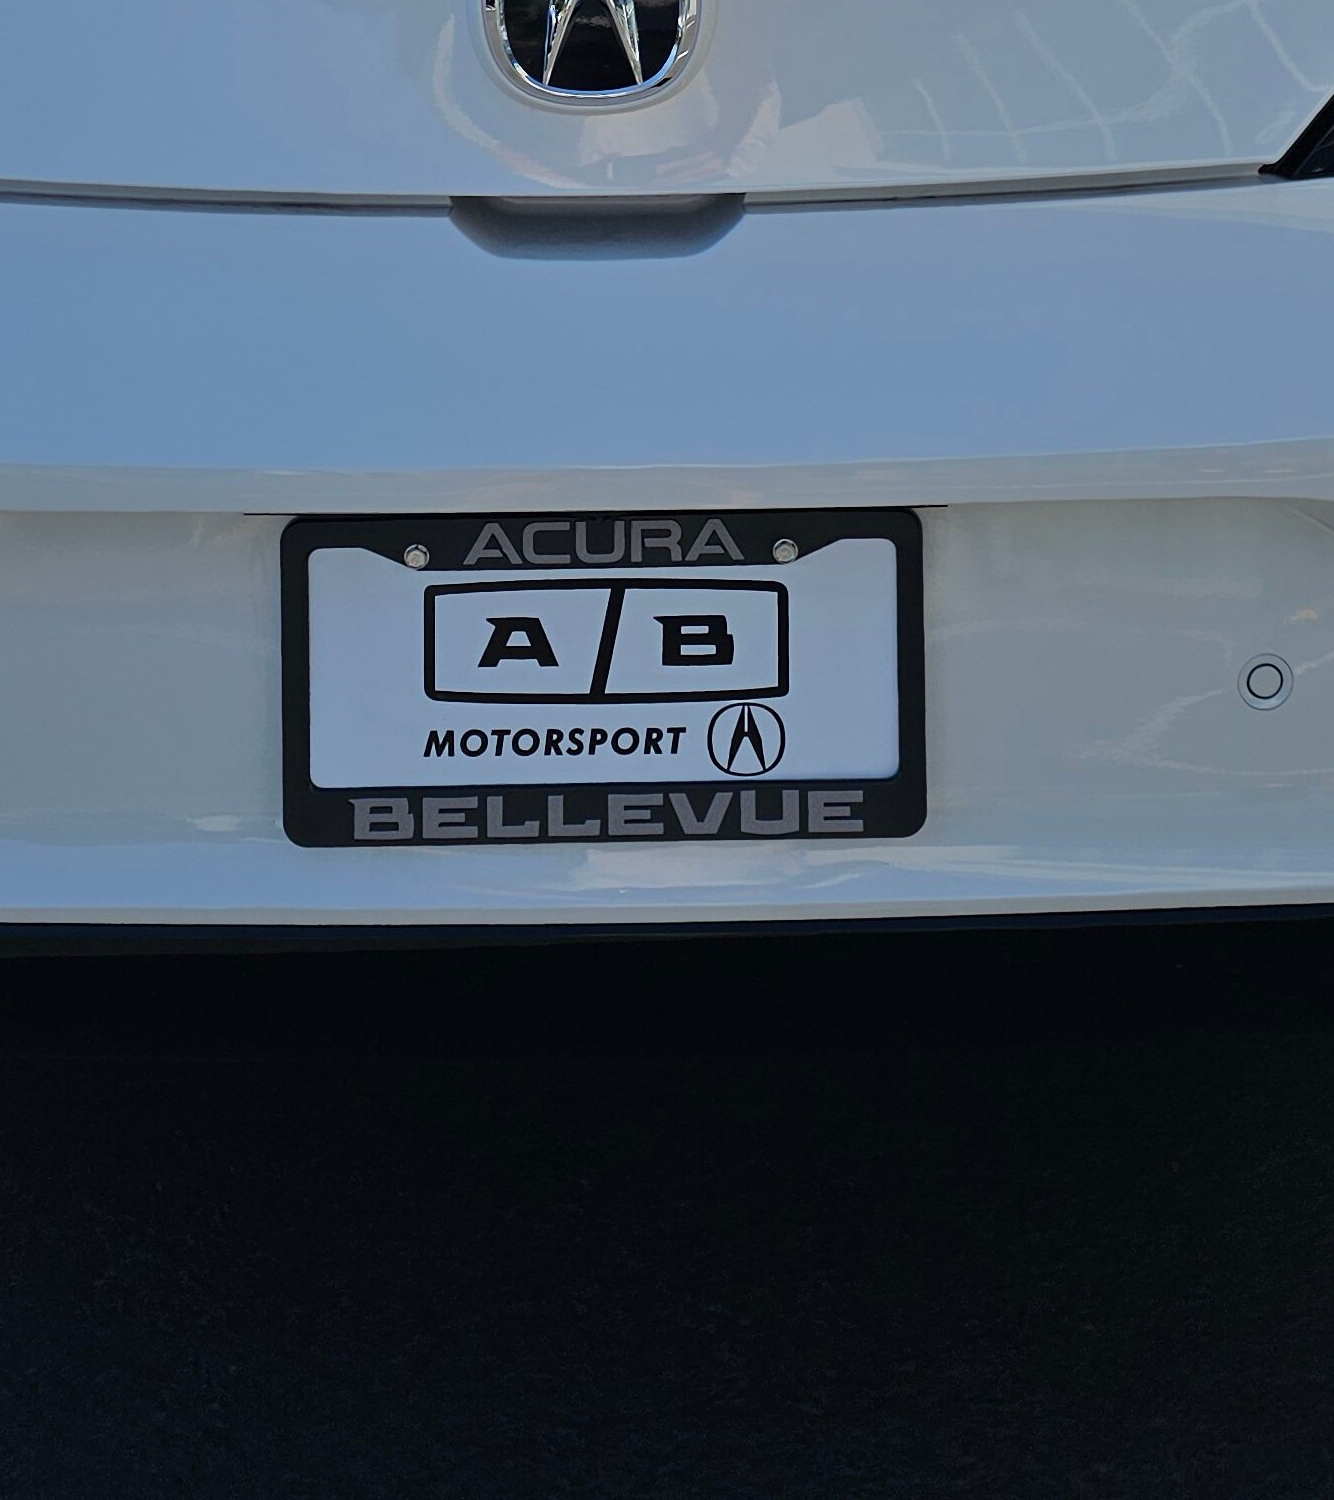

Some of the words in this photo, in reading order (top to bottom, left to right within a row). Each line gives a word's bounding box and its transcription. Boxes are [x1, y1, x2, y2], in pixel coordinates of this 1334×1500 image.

[463, 518, 746, 565] ACURA
[423, 726, 687, 758] MOTORSPORT
[348, 789, 865, 841] BELLEVUE
